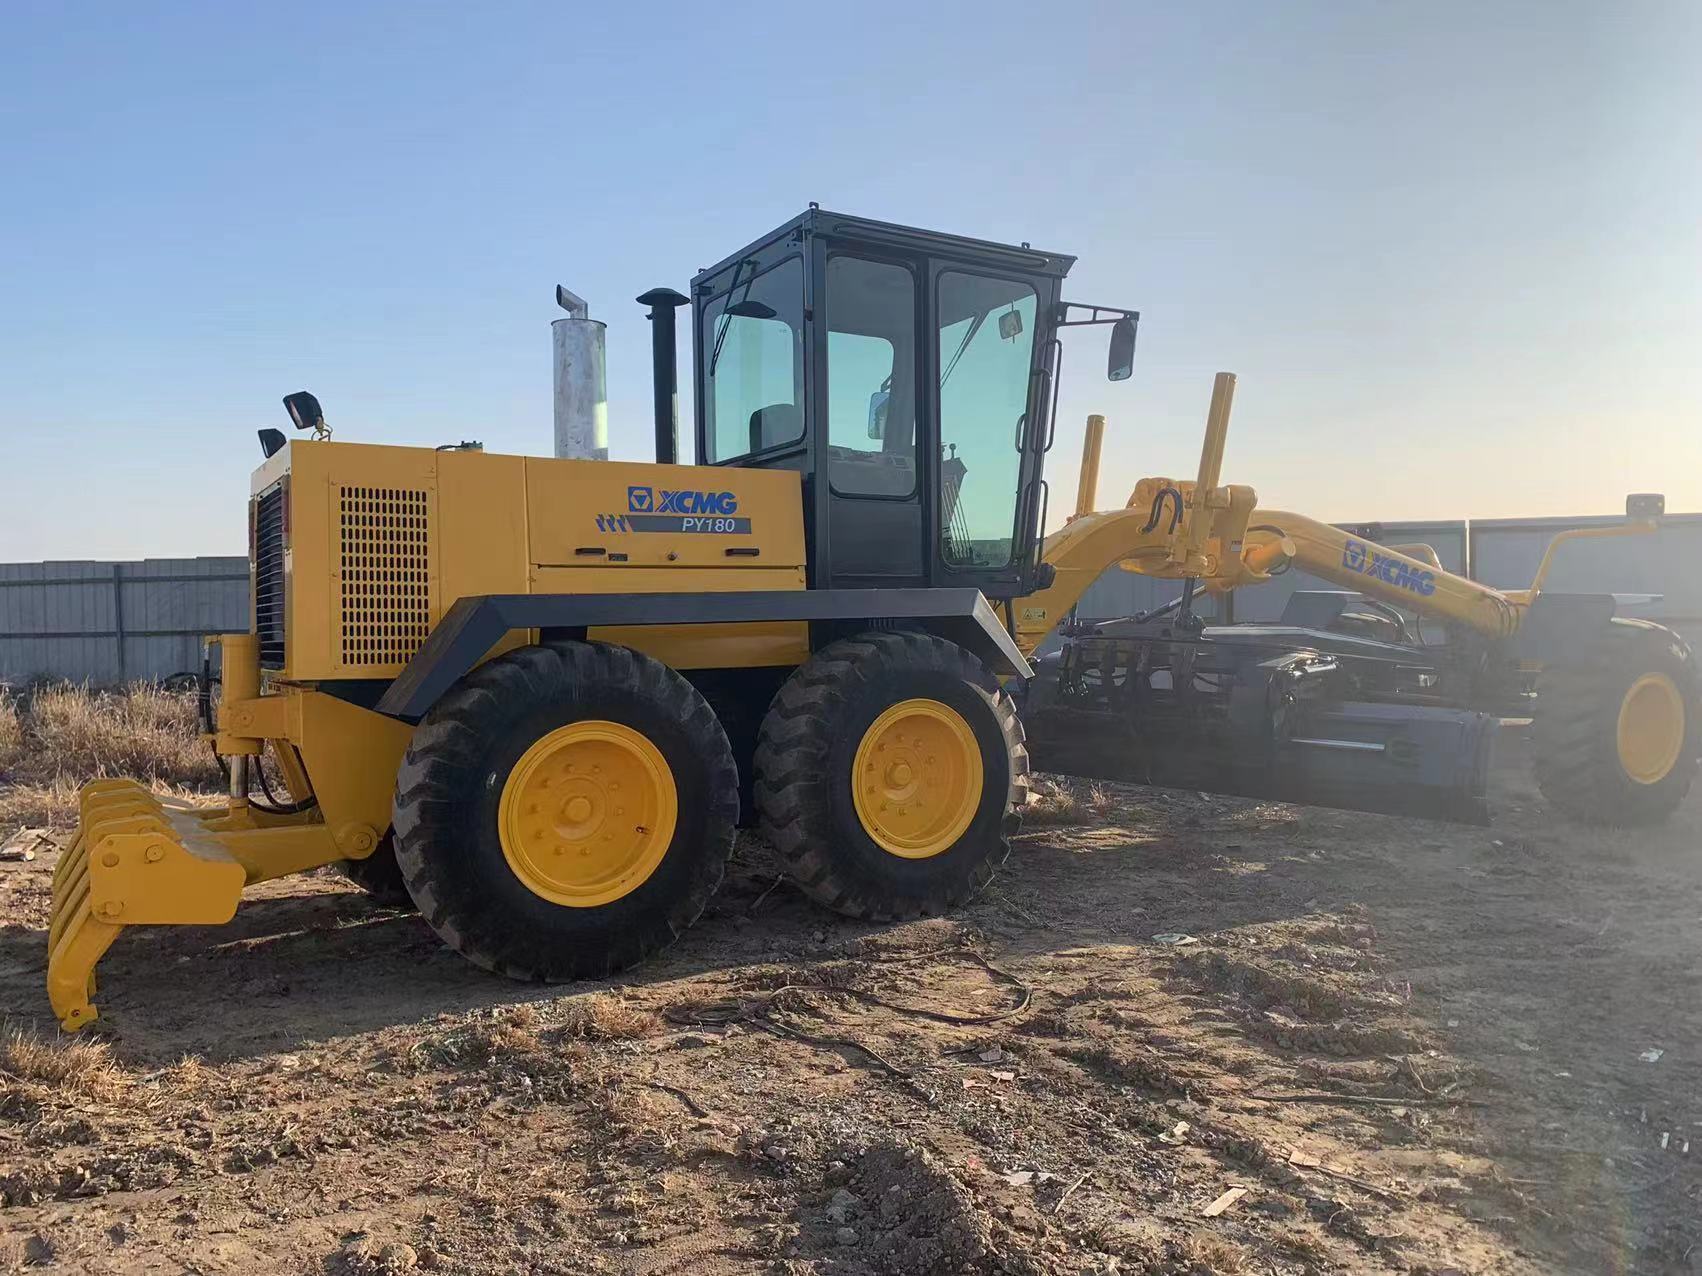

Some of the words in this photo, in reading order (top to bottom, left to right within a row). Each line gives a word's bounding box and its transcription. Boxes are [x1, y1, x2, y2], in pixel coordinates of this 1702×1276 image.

[656, 490, 738, 515] XCMG
[682, 517, 736, 533] PY180
[1365, 553, 1436, 596] XCMG
